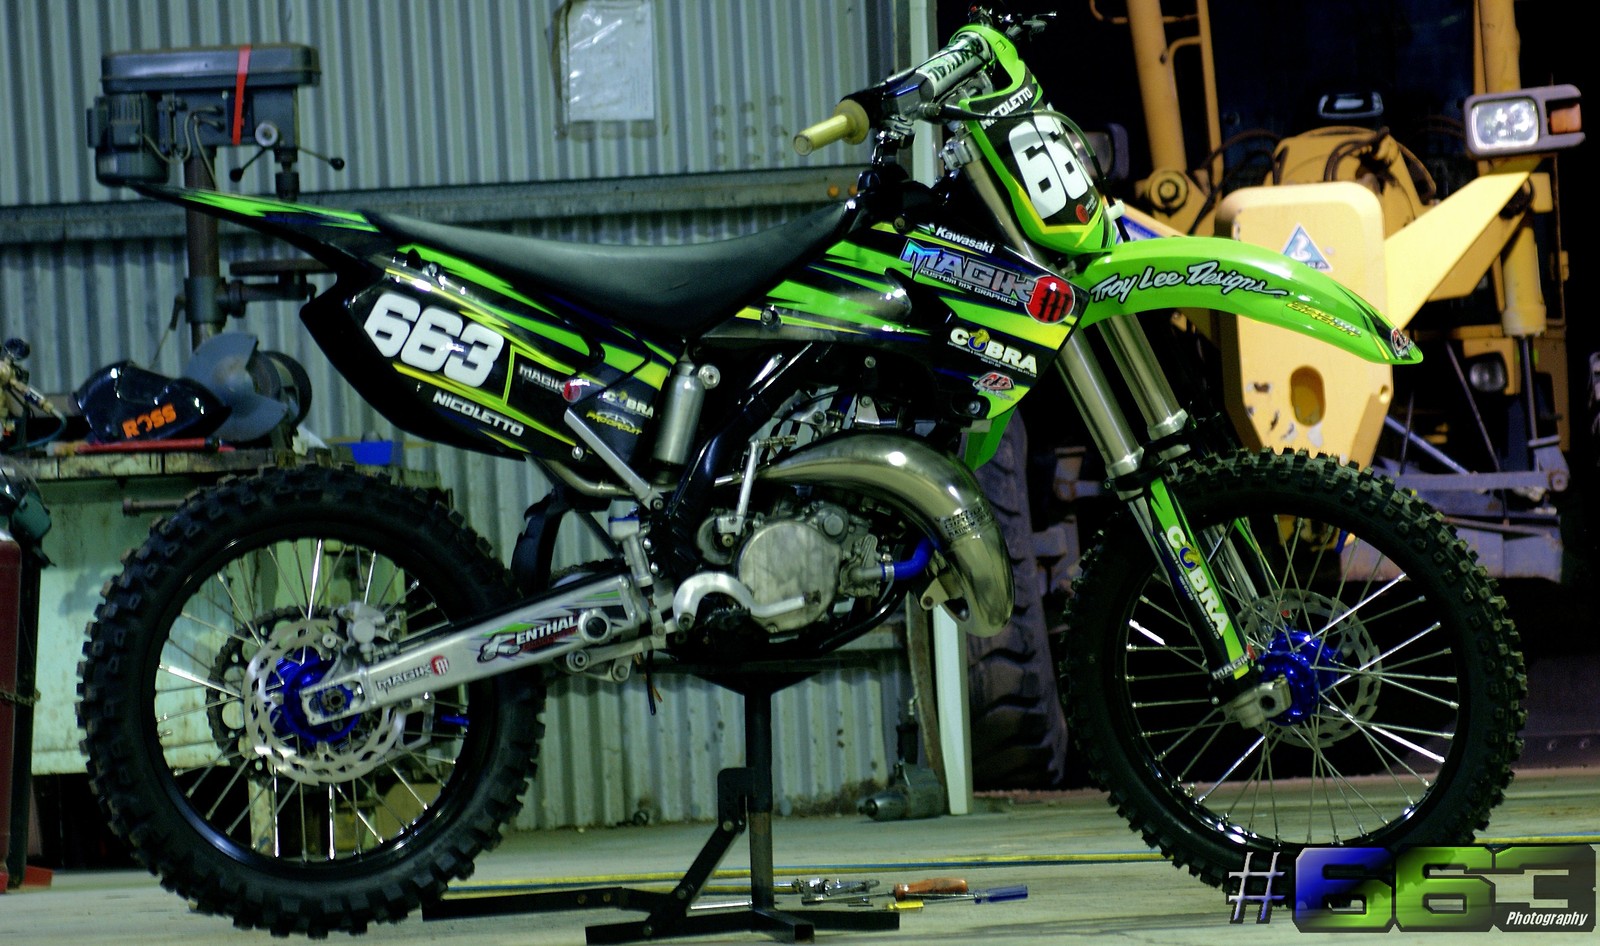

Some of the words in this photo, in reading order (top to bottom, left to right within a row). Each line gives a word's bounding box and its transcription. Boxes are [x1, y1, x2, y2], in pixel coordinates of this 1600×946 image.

[1008, 100, 1094, 220] 66
[935, 225, 996, 255] Kawasaki
[900, 238, 1037, 305] MAGIK
[919, 268, 957, 286] KUSTOM
[958, 281, 974, 292] MX
[974, 286, 1019, 307] GRAPHICS
[1091, 274, 1138, 303] Troy
[1137, 266, 1185, 291] Lee
[1187, 260, 1290, 296] Designs
[363, 290, 505, 388] 663
[950, 326, 1038, 375] COBRA
[432, 390, 525, 438] NICOLETTO
[1166, 525, 1230, 637] COBRA
